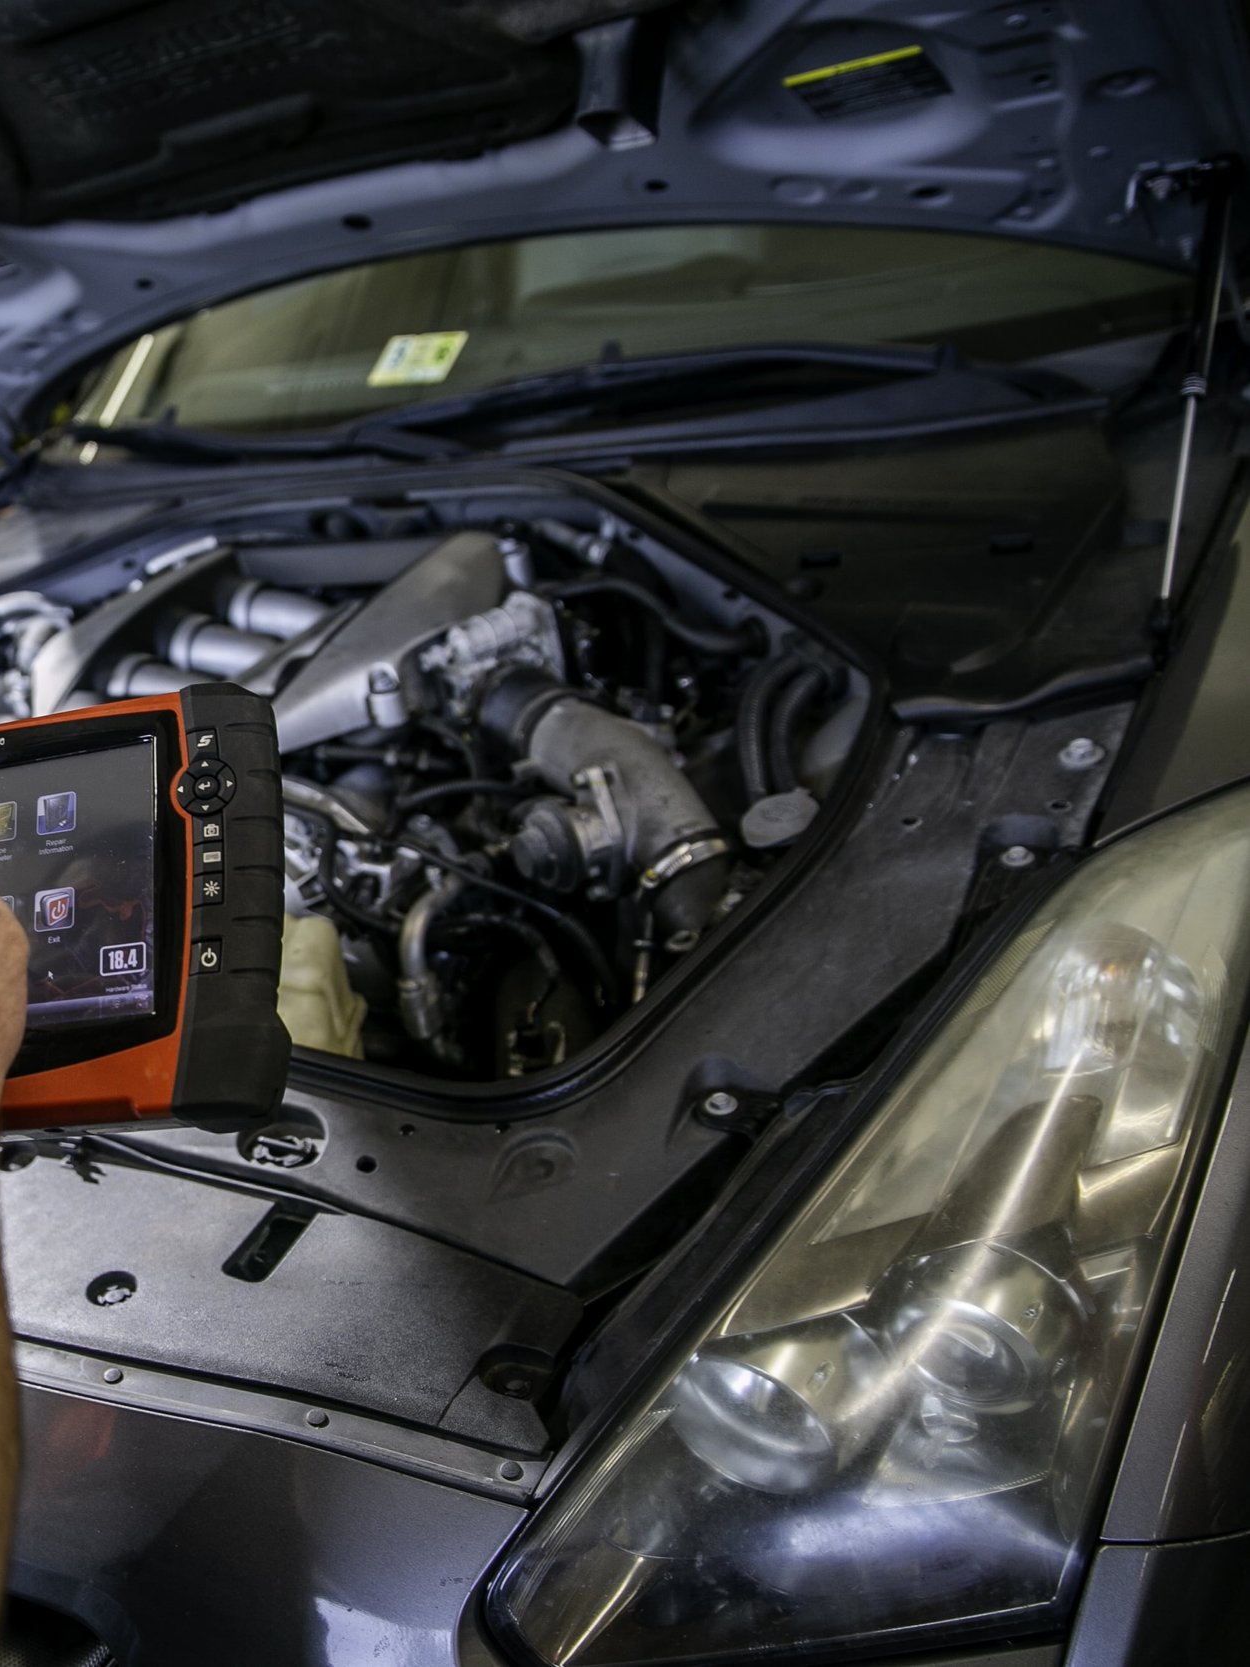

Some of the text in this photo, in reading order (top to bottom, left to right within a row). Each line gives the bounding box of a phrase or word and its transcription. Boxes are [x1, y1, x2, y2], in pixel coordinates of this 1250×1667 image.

[45, 838, 67, 847] Repair
[38, 845, 74, 855] Information
[47, 936, 61, 944] Exit
[108, 949, 137, 970] 18.4
